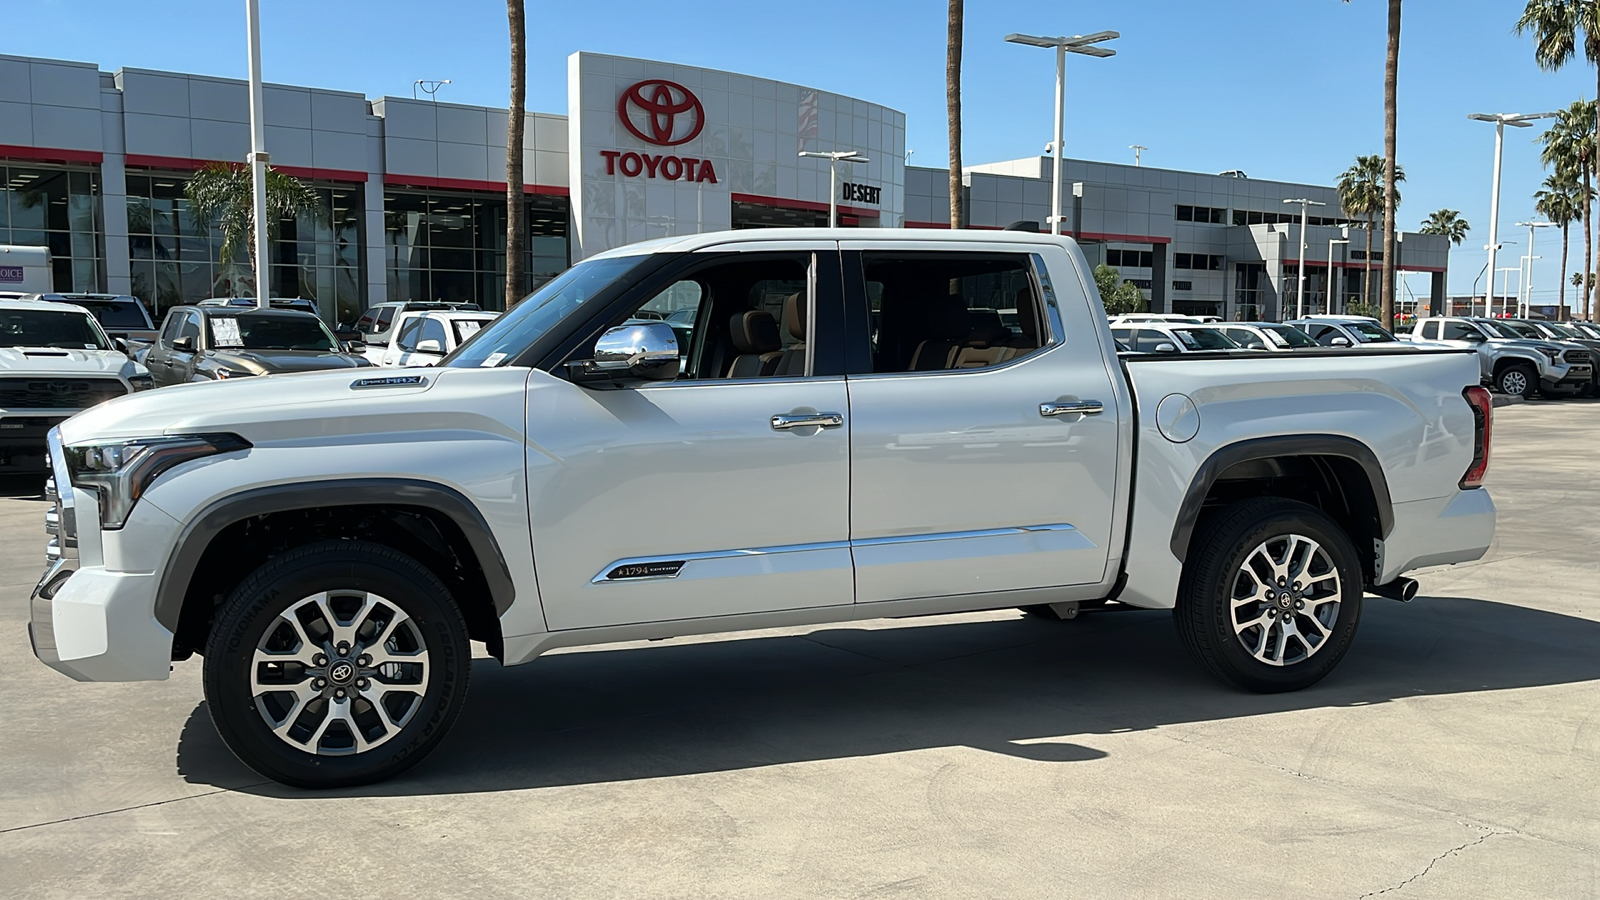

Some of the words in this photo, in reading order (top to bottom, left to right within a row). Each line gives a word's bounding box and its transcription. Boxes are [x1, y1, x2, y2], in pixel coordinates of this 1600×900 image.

[599, 150, 718, 184] TOYOTA
[843, 182, 882, 205] DESERT
[0, 268, 23, 278] OICE
[625, 566, 648, 575] 1794
[227, 589, 280, 653] YOKOHAMA
[421, 621, 456, 737] GEOLANDAR
